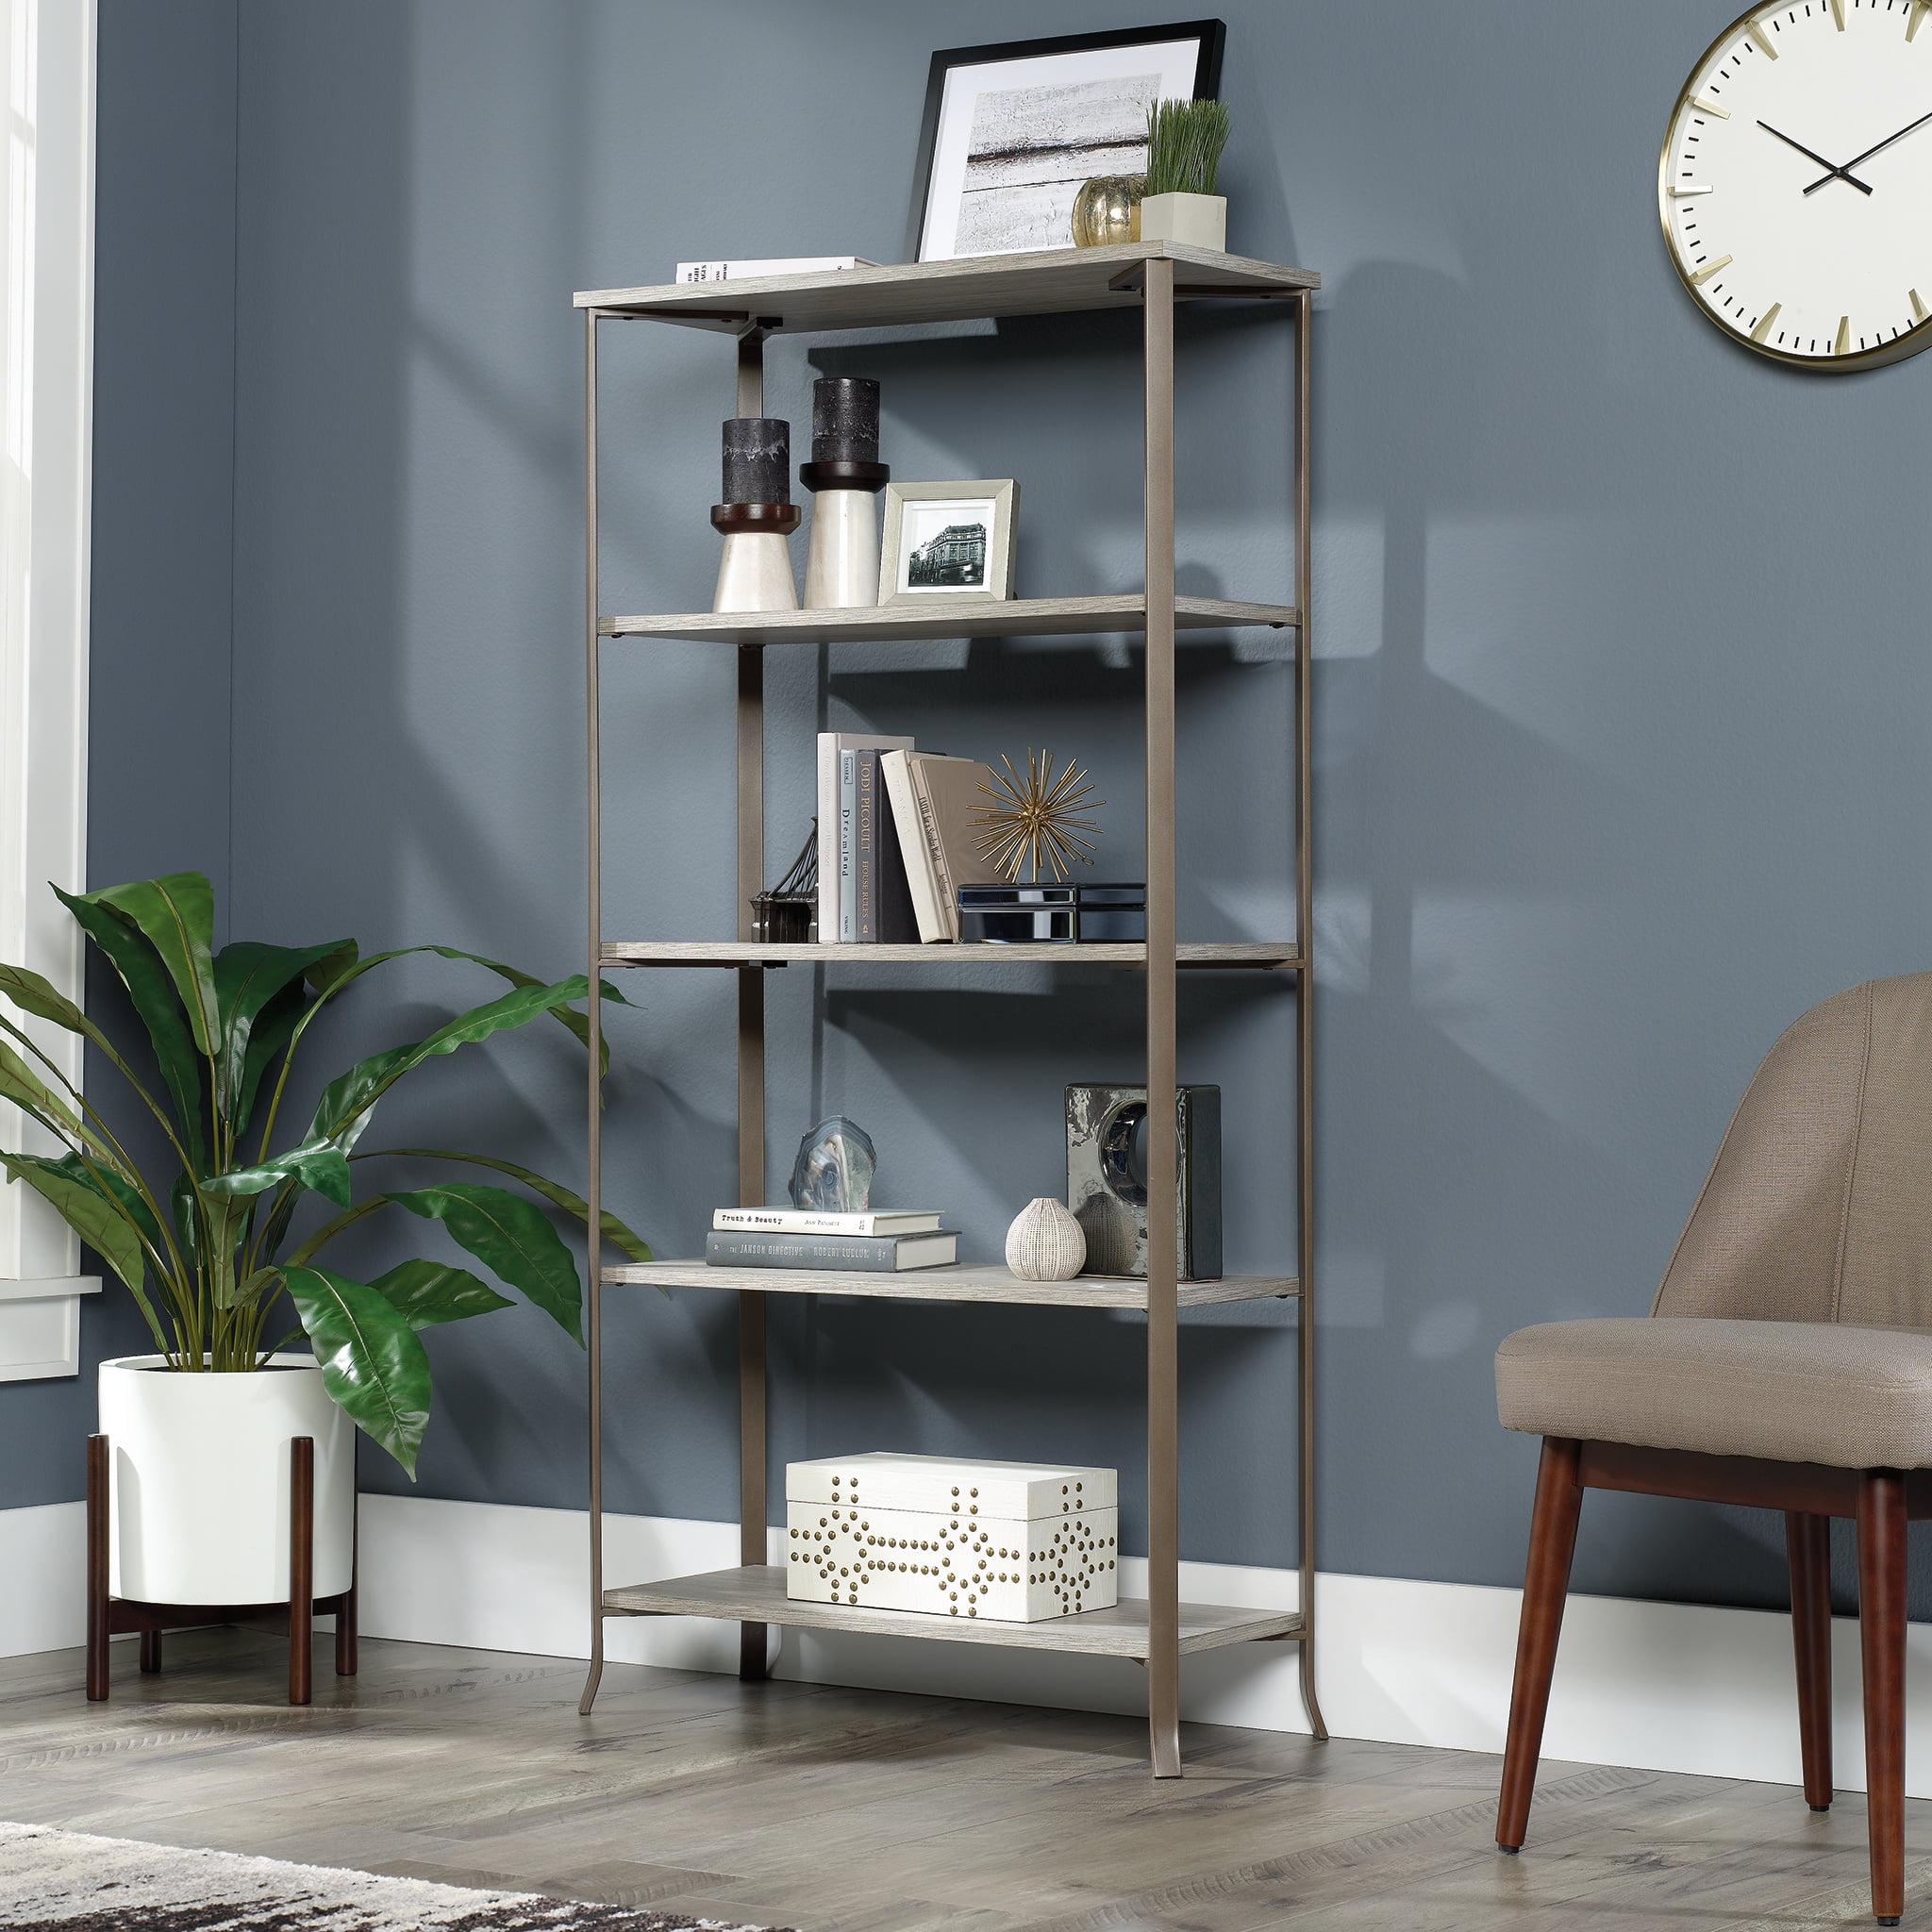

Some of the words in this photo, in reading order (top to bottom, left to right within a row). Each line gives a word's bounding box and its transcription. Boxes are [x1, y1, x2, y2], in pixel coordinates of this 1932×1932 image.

[860, 762, 871, 792] JODI
[860, 797, 871, 852] PICOULT
[722, 1214, 744, 1223] Truth
[755, 1216, 783, 1225] Beauty
[740, 1244, 766, 1255] JANSON
[768, 1245, 804, 1257] DIRECTIVE
[813, 1246, 840, 1257] ROBERT
[841, 1247, 870, 1258] LUDLUM
